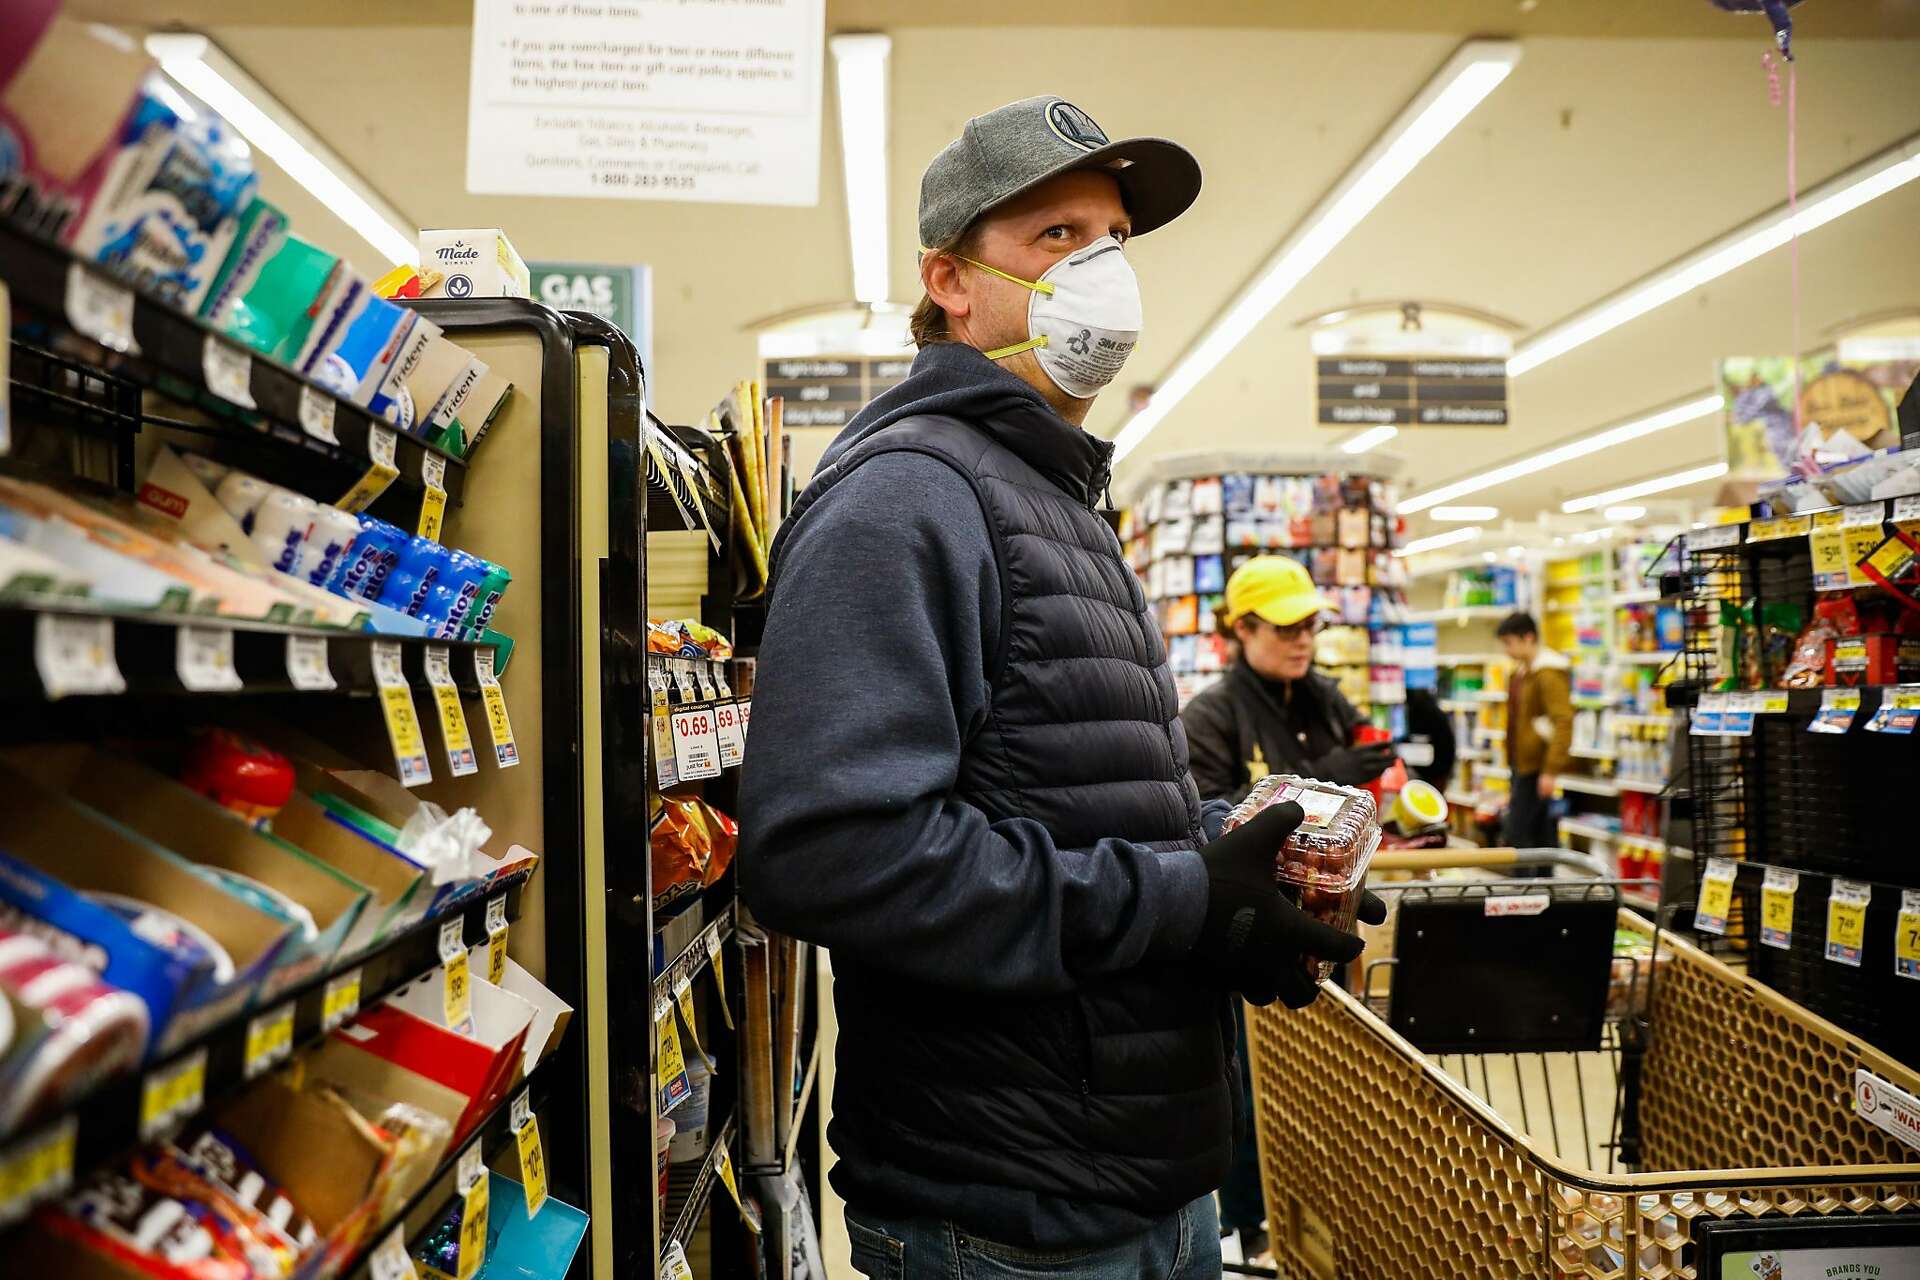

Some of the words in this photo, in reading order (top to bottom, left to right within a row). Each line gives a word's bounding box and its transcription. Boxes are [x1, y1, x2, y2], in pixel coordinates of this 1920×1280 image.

[436, 246, 480, 261] Made
[540, 273, 614, 305] GAS
[1098, 337, 1116, 350] 3M
[390, 333, 430, 390] Trident
[440, 367, 479, 420] Trident
[675, 715, 708, 737] $0.69
[1826, 1263, 1861, 1278] BRANDS
[1863, 1263, 1881, 1276] YOU
